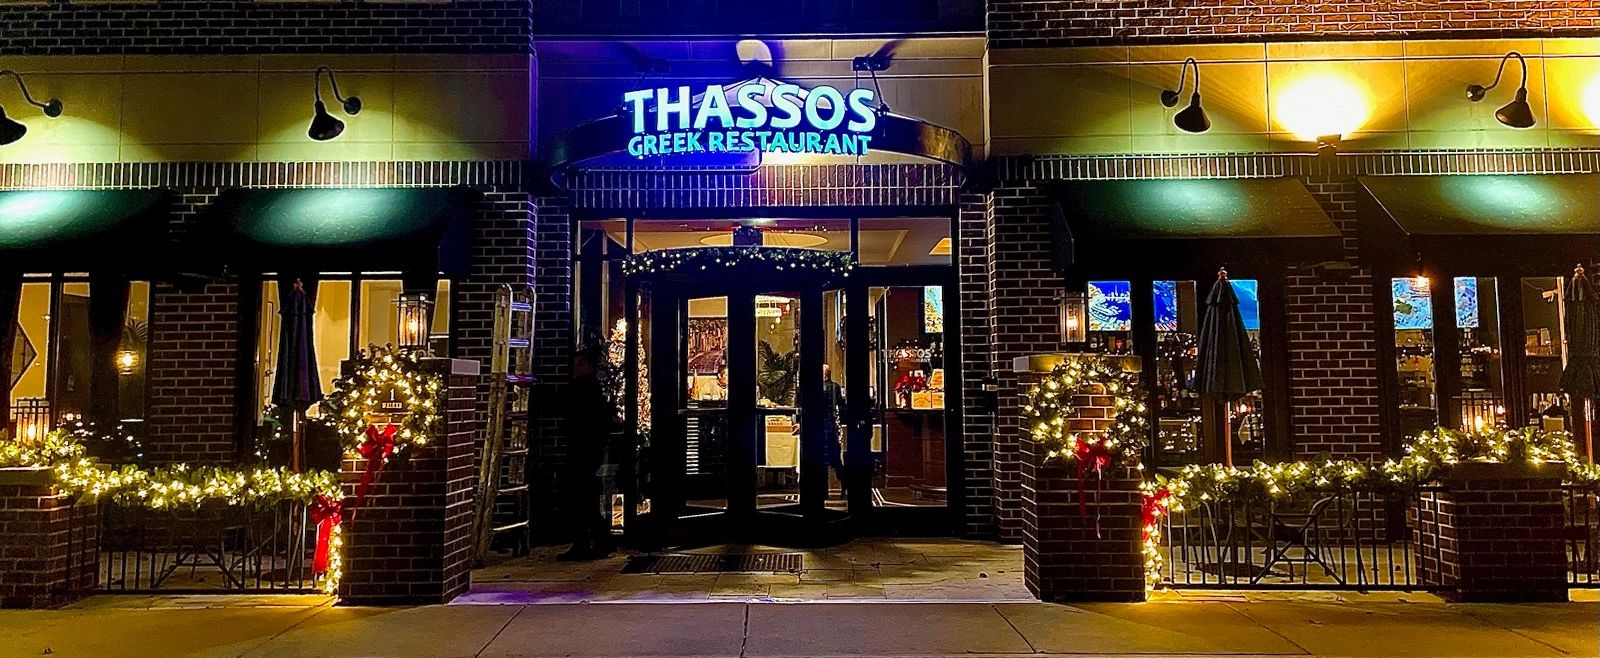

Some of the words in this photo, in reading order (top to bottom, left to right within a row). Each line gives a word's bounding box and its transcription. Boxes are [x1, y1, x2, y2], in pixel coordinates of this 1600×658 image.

[624, 84, 876, 132] THASSOS
[628, 132, 701, 156] GREEK
[708, 131, 872, 155] RESTAURANT
